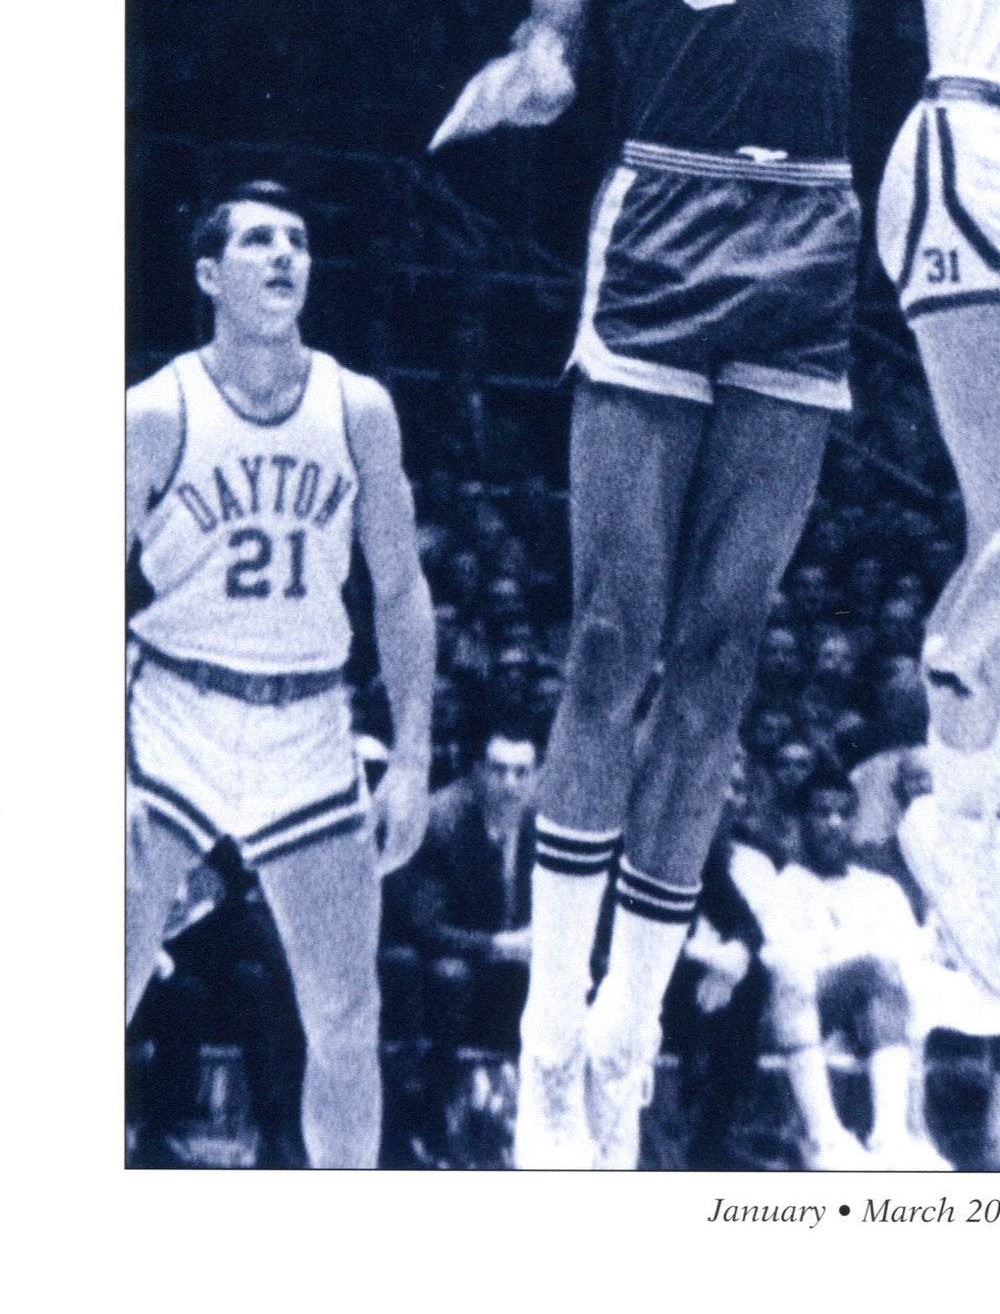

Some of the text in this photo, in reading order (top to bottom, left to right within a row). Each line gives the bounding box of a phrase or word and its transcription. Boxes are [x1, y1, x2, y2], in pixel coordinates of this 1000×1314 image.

[923, 247, 961, 284] 31
[176, 454, 352, 533] DAYTON
[225, 527, 307, 599] 21
[706, 1198, 827, 1229] January
[861, 1196, 955, 1223] March
